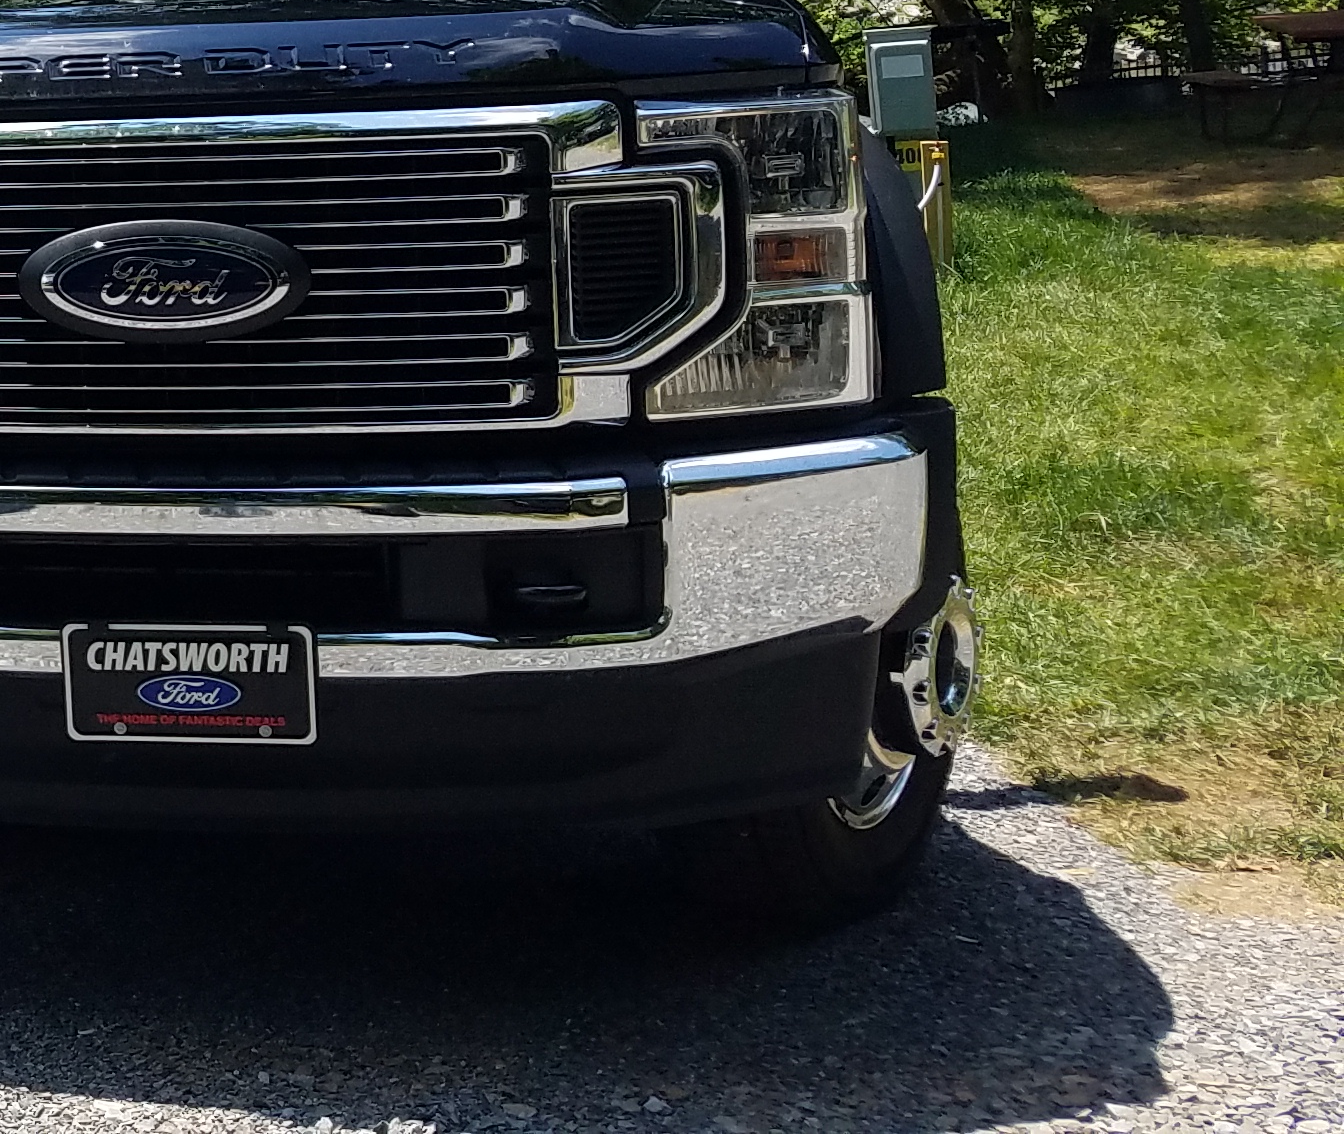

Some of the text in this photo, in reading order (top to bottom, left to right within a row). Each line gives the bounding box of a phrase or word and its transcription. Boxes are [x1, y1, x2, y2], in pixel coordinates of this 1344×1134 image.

[203, 37, 476, 75] DUTY
[895, 148, 920, 164] 40
[100, 256, 231, 306] Ford
[86, 641, 289, 673] CHATSWORTH
[157, 679, 221, 705] Ford
[97, 714, 286, 727] THE HOME OF FANTASTIC DEALS
